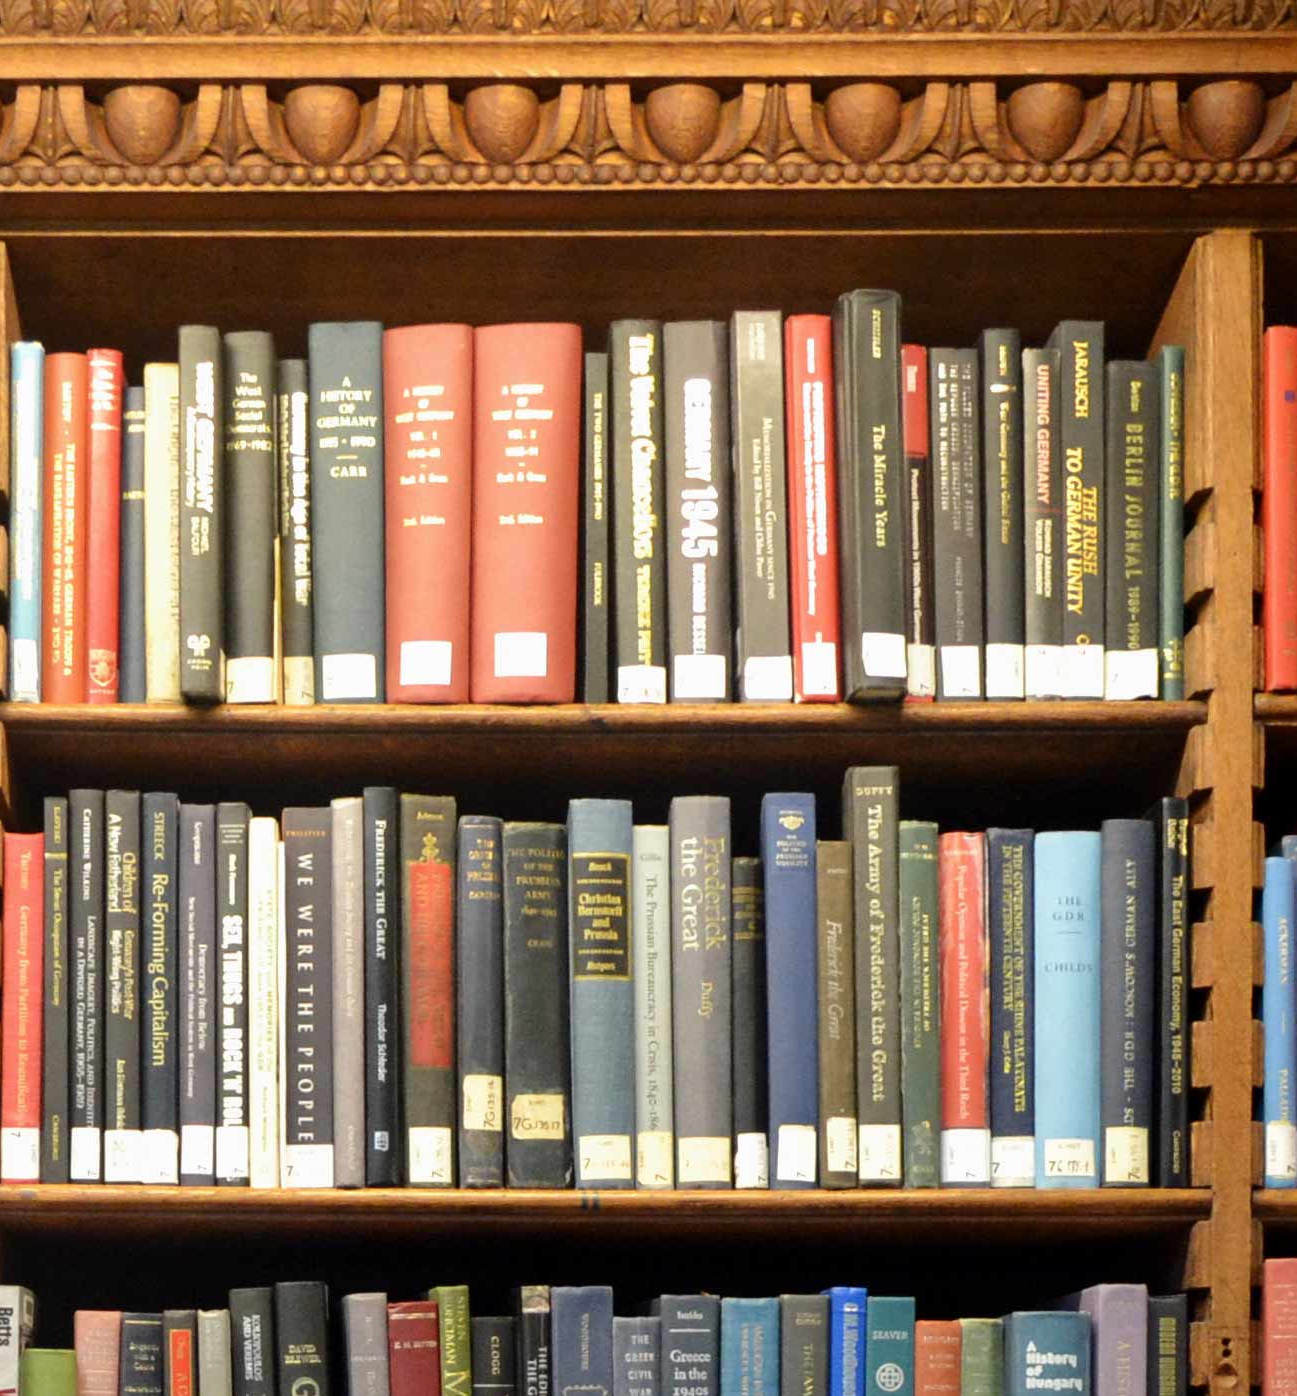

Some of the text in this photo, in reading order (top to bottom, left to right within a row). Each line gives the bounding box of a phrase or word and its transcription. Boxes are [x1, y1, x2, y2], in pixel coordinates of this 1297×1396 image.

[321, 391, 371, 402] HISTORY
[342, 376, 351, 387] A
[1073, 341, 1089, 418] JARAUSCH
[317, 416, 377, 428] GERMANY
[340, 404, 355, 414] OF
[1037, 364, 1050, 503] UNITING GERMANY
[330, 466, 367, 478] CARR
[681, 485, 719, 558] 1945
[1125, 424, 1143, 580] BERLIN JOURNAL
[1066, 448, 1083, 614] TO GERMAN UNITY
[1082, 486, 1098, 575] THE RUSH
[681, 837, 703, 951] the Great
[702, 837, 727, 950] Frederick
[148, 813, 170, 1067] STREECK Re-Forming Capitalism
[865, 804, 887, 1102] The Army of Frederick the Great
[297, 853, 314, 1142] WE WERE THE PEOPLE
[670, 1350, 711, 1364] Greece
[1026, 1341, 1036, 1352] A
[1027, 1353, 1077, 1366] History
[674, 1367, 706, 1380] in the
[1027, 1367, 1041, 1378] of
[1027, 1378, 1082, 1391] Hungary
